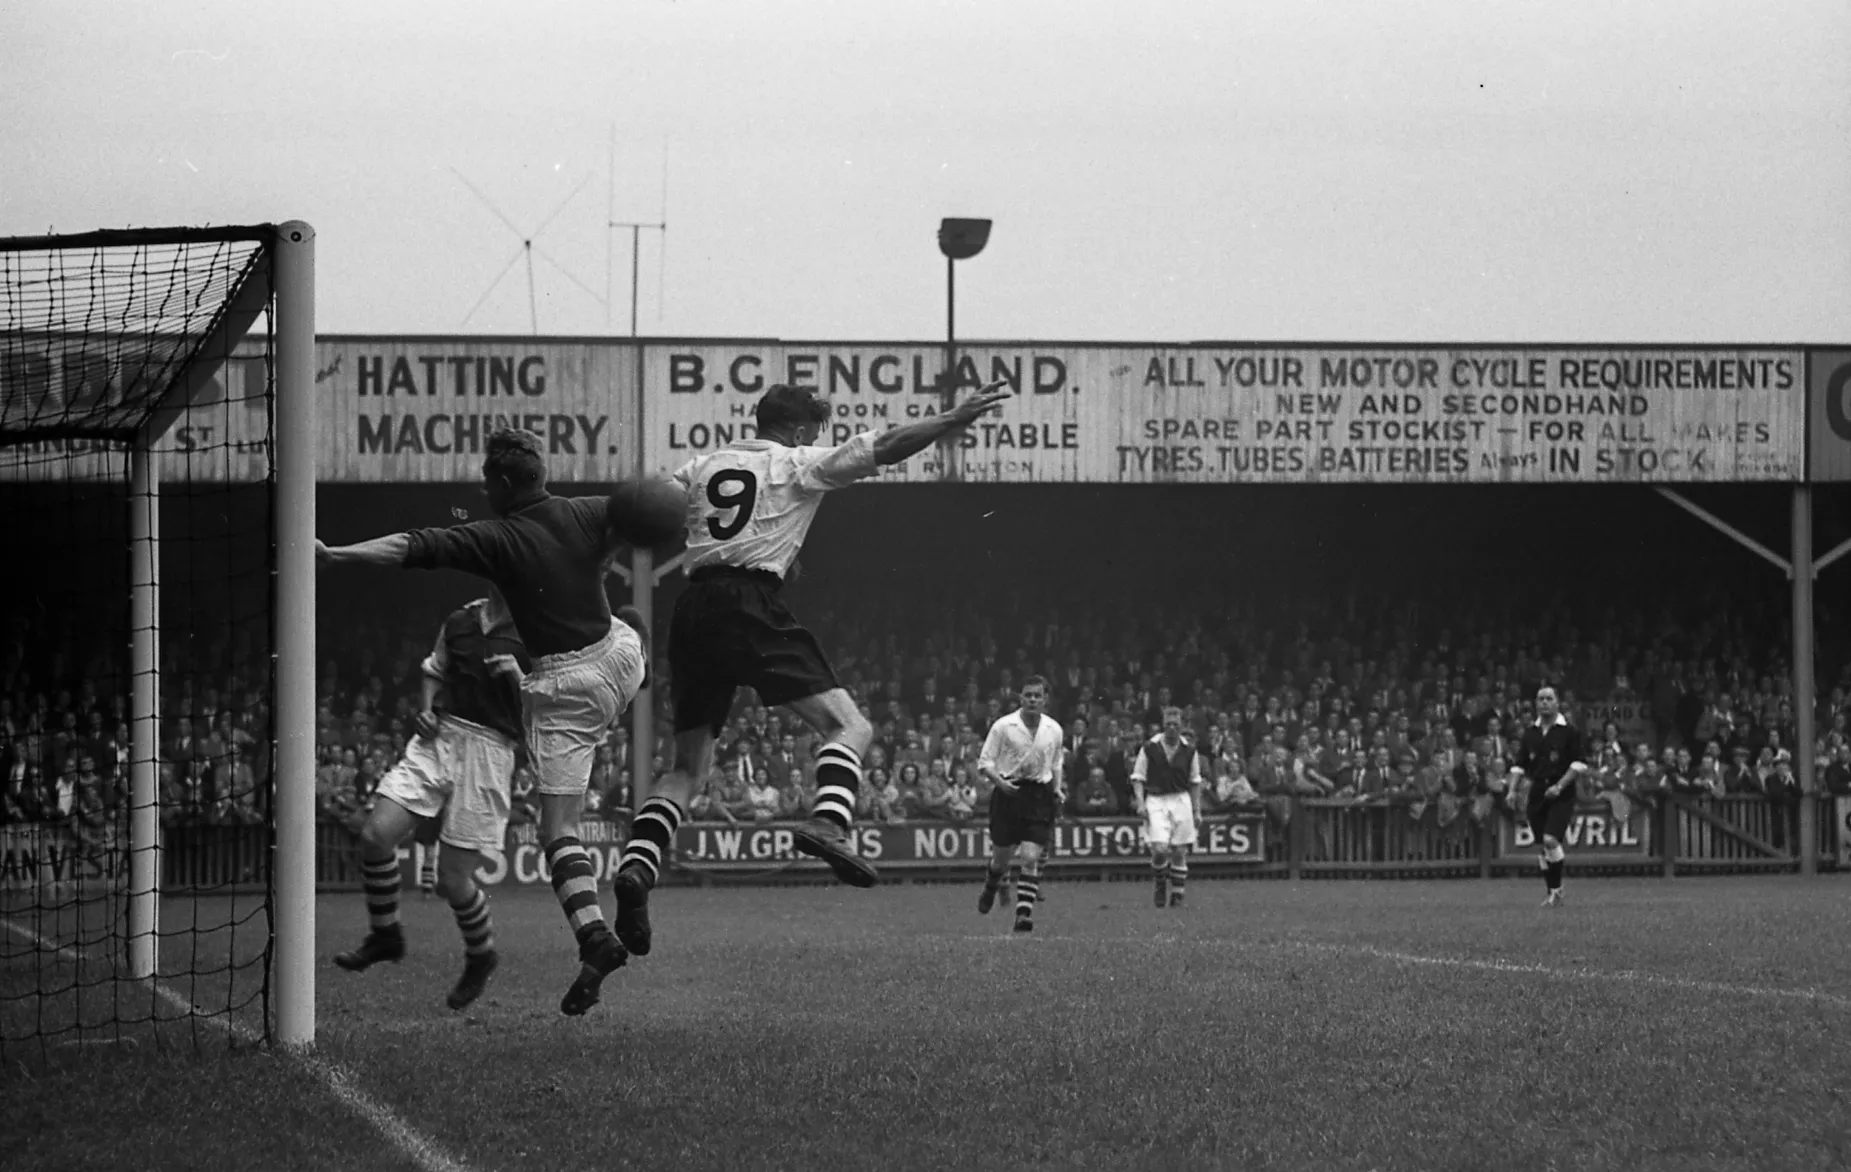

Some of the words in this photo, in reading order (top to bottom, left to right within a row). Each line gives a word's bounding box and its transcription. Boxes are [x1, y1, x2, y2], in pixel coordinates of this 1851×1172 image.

[357, 355, 547, 396] HATTING
[787, 354, 1081, 395] ENGLAND.
[1144, 357, 1205, 387] ALL
[1214, 357, 1303, 387] YOUR
[1320, 358, 1439, 387] MOTOR
[1451, 358, 1546, 388] CYCLE
[1559, 358, 1793, 390] REQUIREMENTS
[836, 404, 888, 417] OON
[1277, 394, 1341, 413] NEW
[1359, 395, 1421, 414] AND
[1442, 395, 1648, 415] SECONDHAND
[669, 423, 757, 449] LOND
[1144, 419, 1239, 440] SPARE
[1256, 420, 1333, 440] PART
[1348, 420, 1485, 441] STOCKIST
[1529, 421, 1584, 441] FOR
[1601, 422, 1655, 442] ALL
[1321, 447, 1469, 474] BATTERIES
[1550, 448, 1580, 474] IN
[706, 468, 757, 541] 9
[915, 828, 993, 857] NOTE
[1192, 824, 1250, 853] LES
[1514, 815, 1639, 846] BVRIL
[515, 845, 621, 882] COOA
